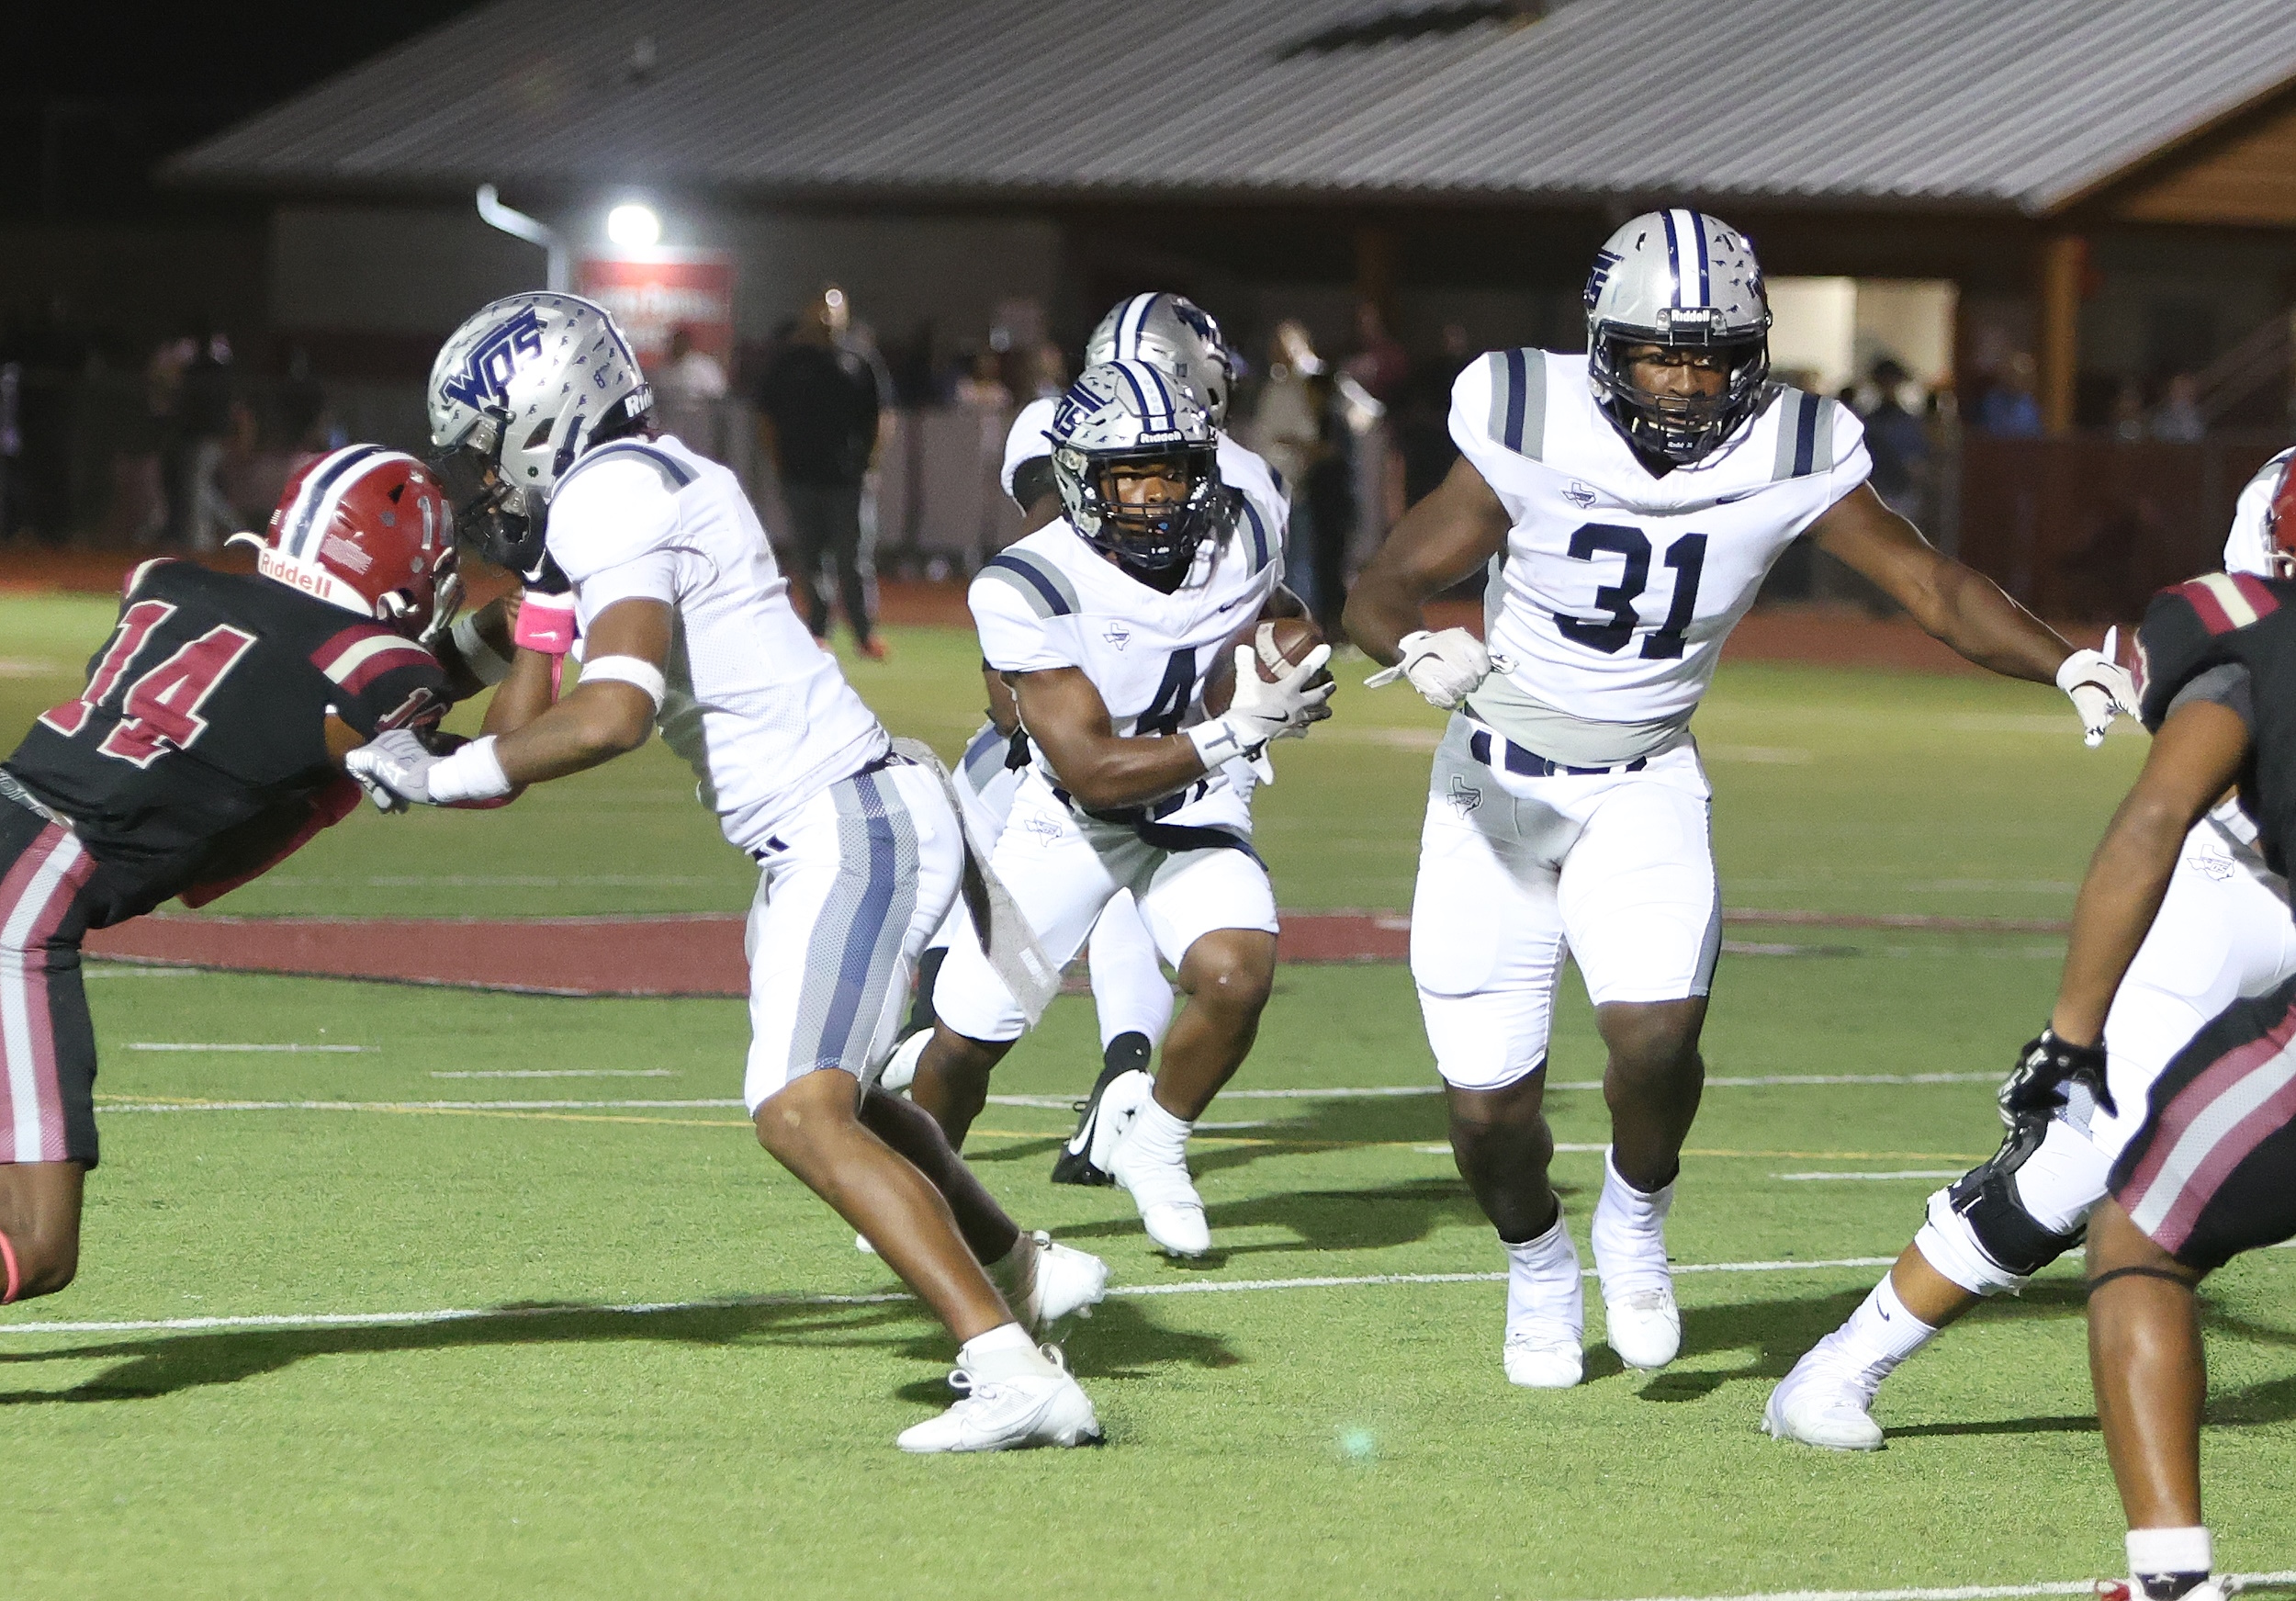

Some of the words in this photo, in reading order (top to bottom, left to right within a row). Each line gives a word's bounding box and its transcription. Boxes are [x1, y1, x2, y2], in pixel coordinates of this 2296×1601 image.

[439, 302, 544, 413] WOS
[1671, 309, 1710, 321] Riddell
[1140, 431, 1182, 444] Riddell
[261, 553, 332, 599] Riddell
[1553, 522, 1708, 660] 31
[38, 600, 257, 770] 14
[1136, 647, 1197, 736] 4
